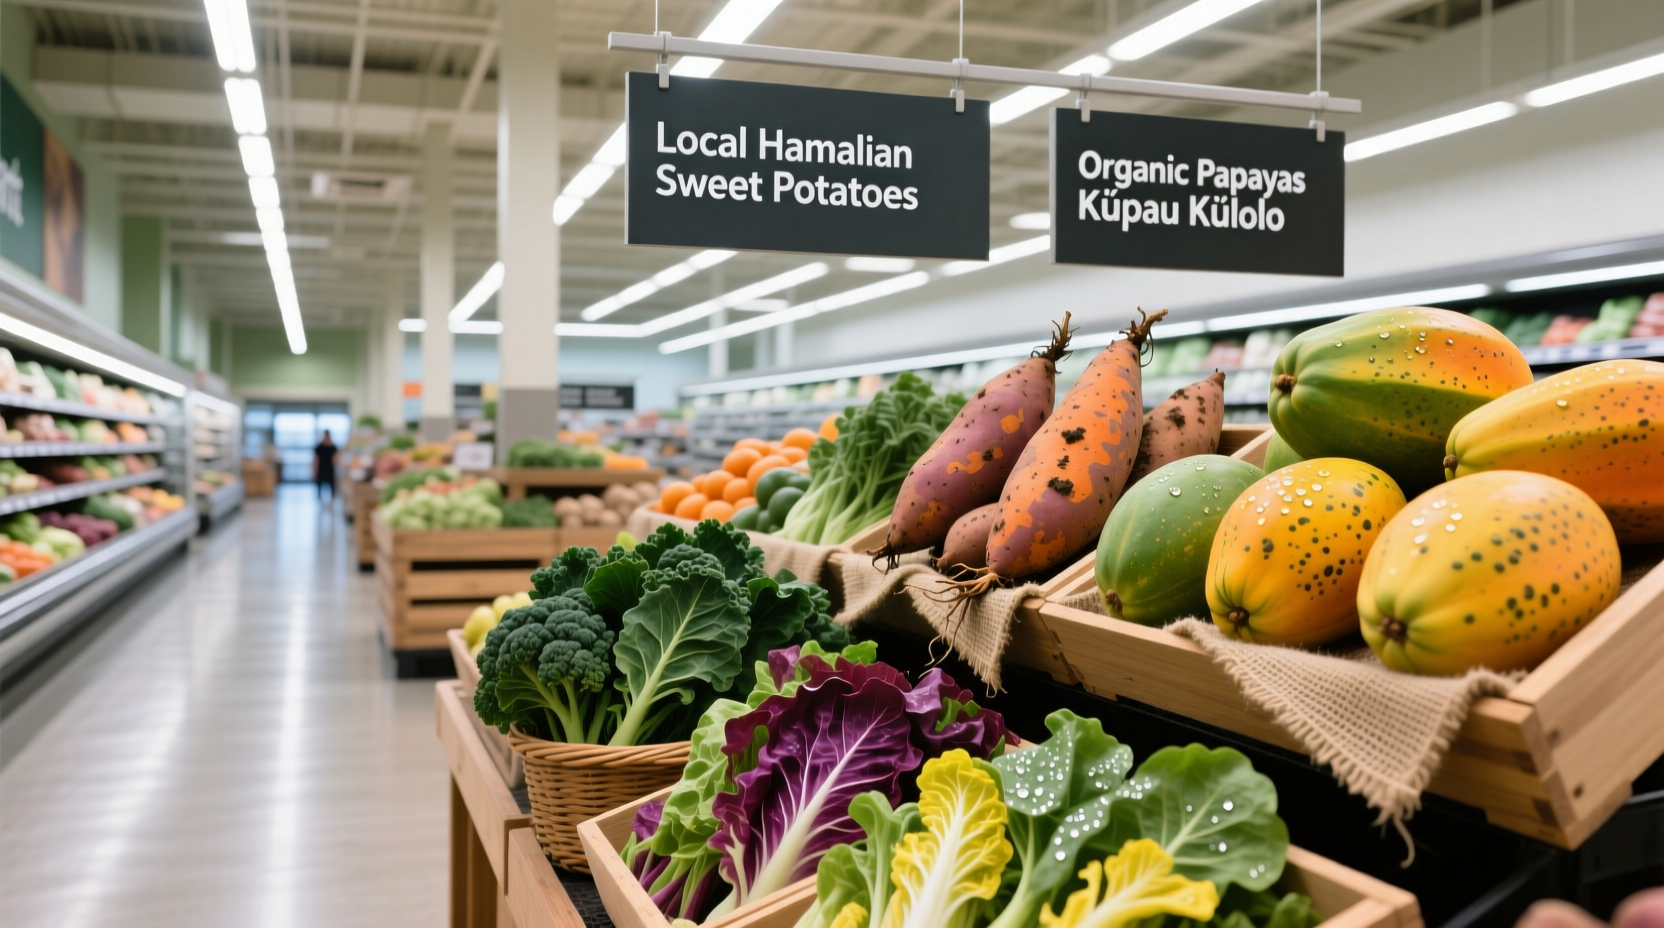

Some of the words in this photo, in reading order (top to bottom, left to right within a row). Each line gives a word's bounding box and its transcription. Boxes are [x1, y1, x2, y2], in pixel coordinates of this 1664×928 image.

[656, 120, 748, 160] Local
[758, 127, 914, 170] Hamalian
[655, 163, 763, 203] Sweet
[773, 170, 919, 211] Potatoes
[1078, 149, 1190, 190] Organic
[1196, 158, 1307, 200] Papayas
